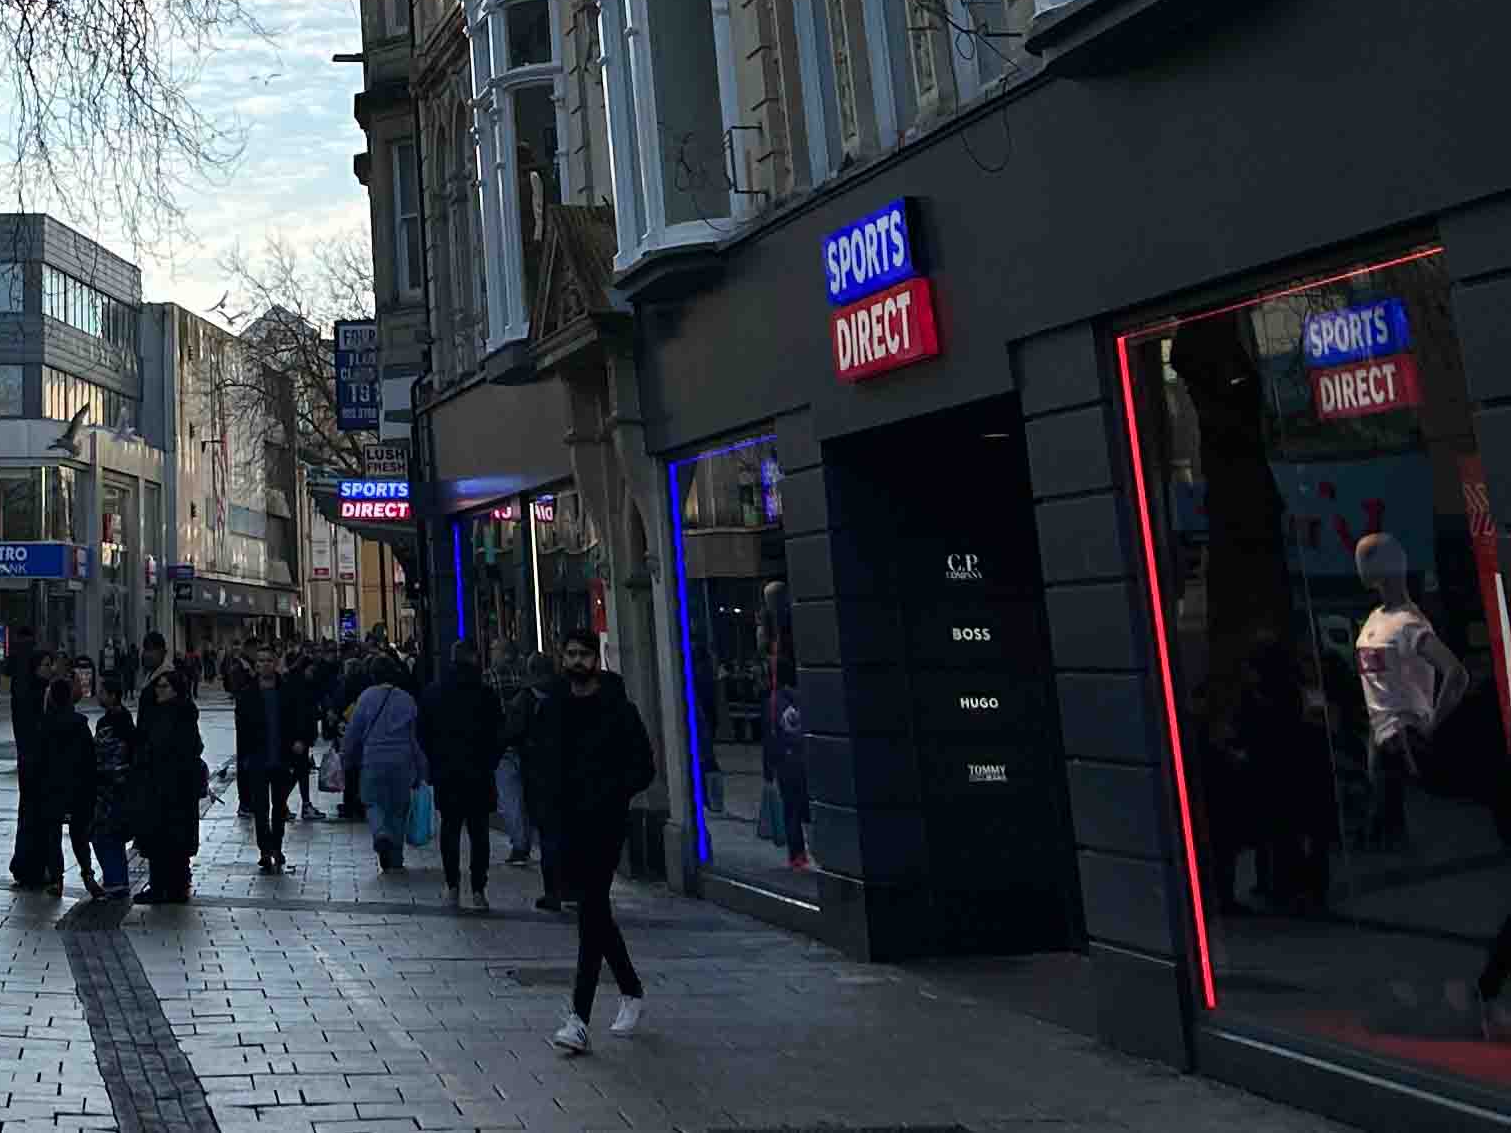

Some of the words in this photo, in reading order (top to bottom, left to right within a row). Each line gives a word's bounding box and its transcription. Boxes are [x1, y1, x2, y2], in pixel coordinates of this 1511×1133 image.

[826, 209, 906, 296] SPORTS
[836, 290, 911, 371] DIRECT
[1309, 305, 1389, 358] SPORTS
[1319, 363, 1396, 413] DIRECT
[366, 449, 406, 460] LUSH
[340, 482, 409, 497] SPORTS
[341, 502, 410, 518] DIRECT
[952, 627, 992, 642] BOSS
[960, 697, 1000, 710] HUGO
[967, 763, 1006, 777] TOMMY
